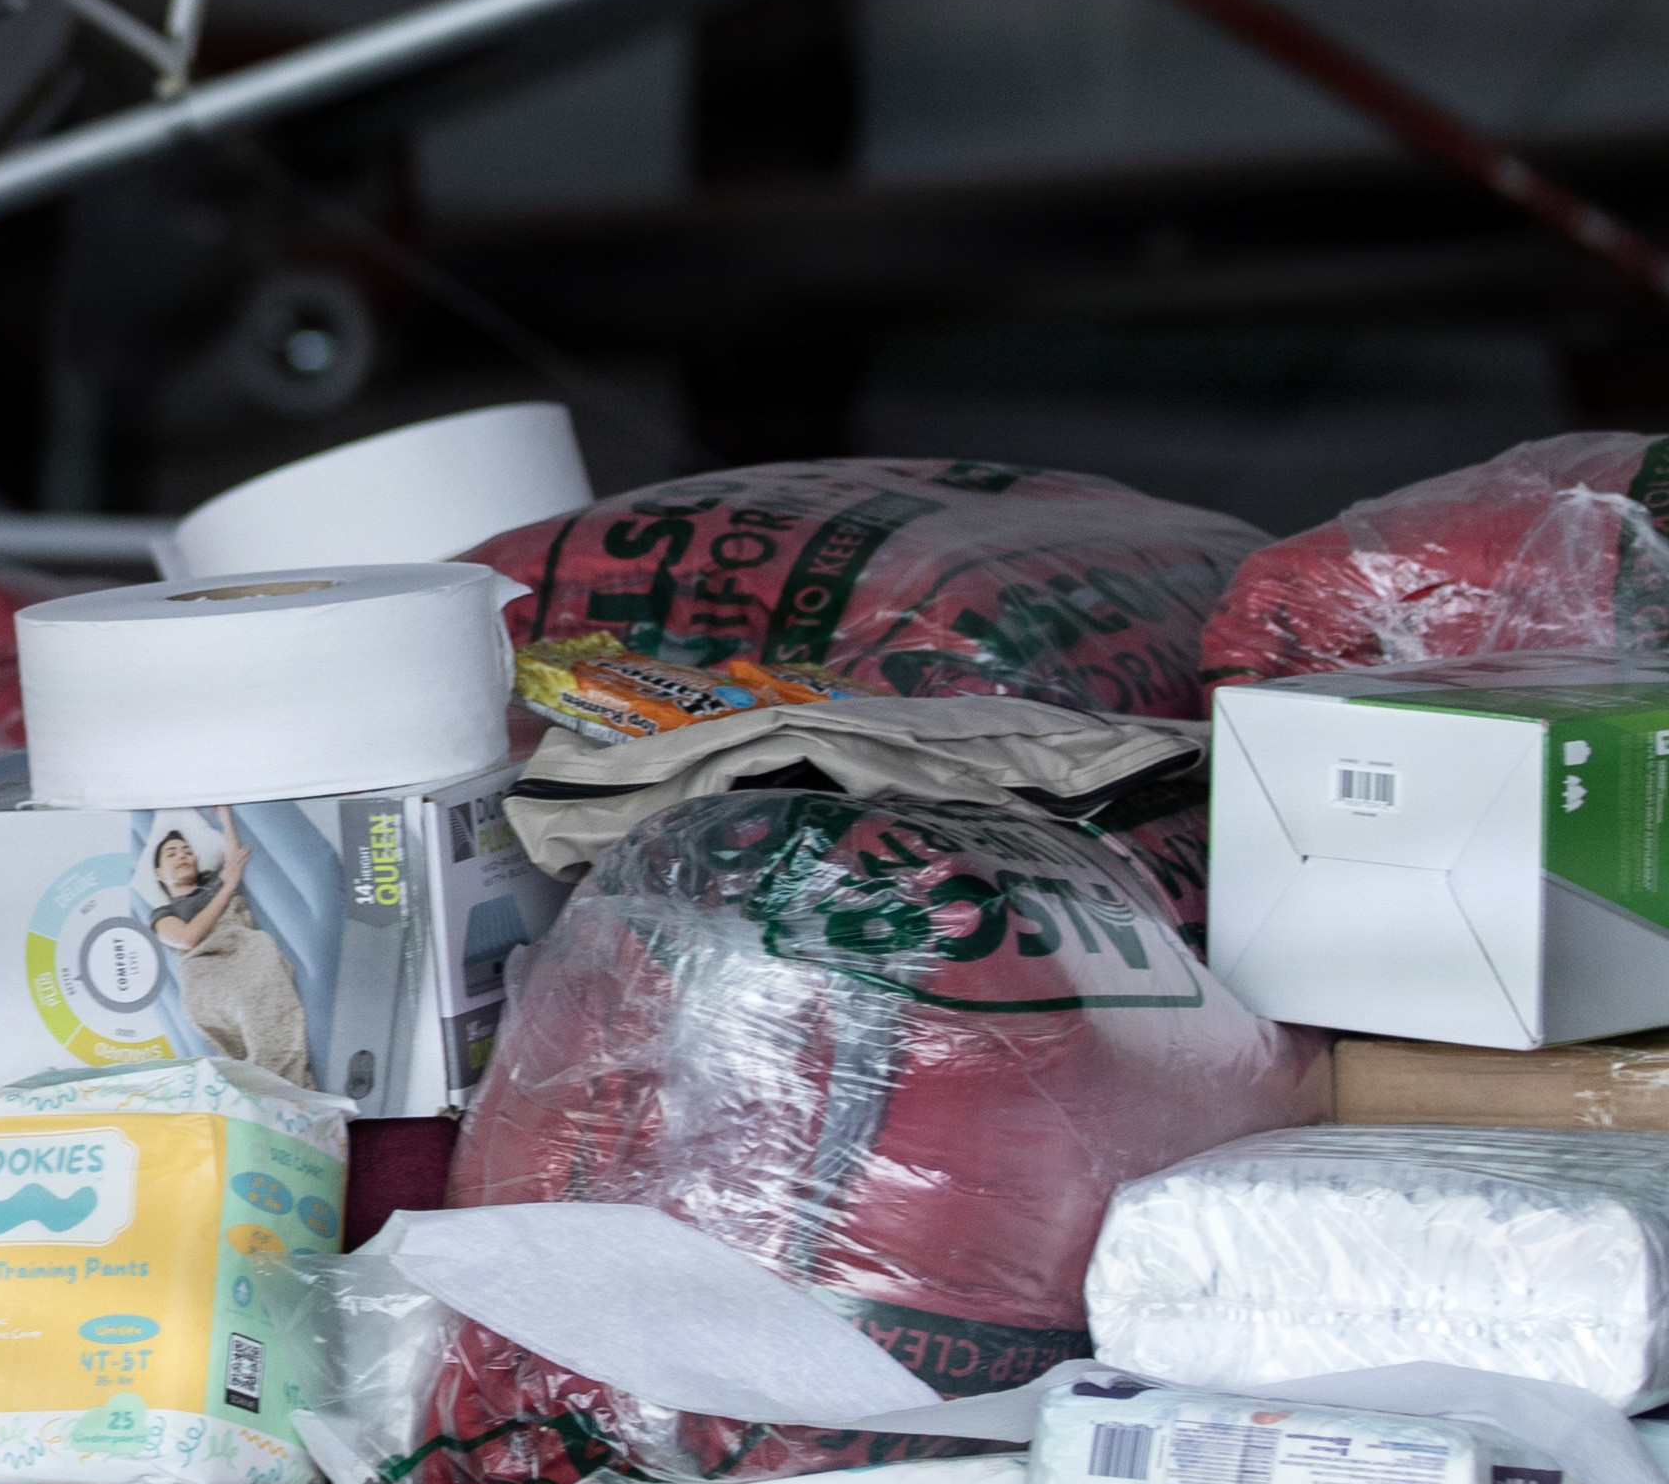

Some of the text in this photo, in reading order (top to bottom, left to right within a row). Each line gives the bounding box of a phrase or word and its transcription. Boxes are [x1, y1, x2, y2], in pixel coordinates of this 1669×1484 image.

[374, 813, 402, 907] QUEEN
[110, 937, 130, 992] COMFORT
[85, 1256, 151, 1279] Pants
[78, 1349, 154, 1374] 4T-5T
[107, 1411, 134, 1430] 25
